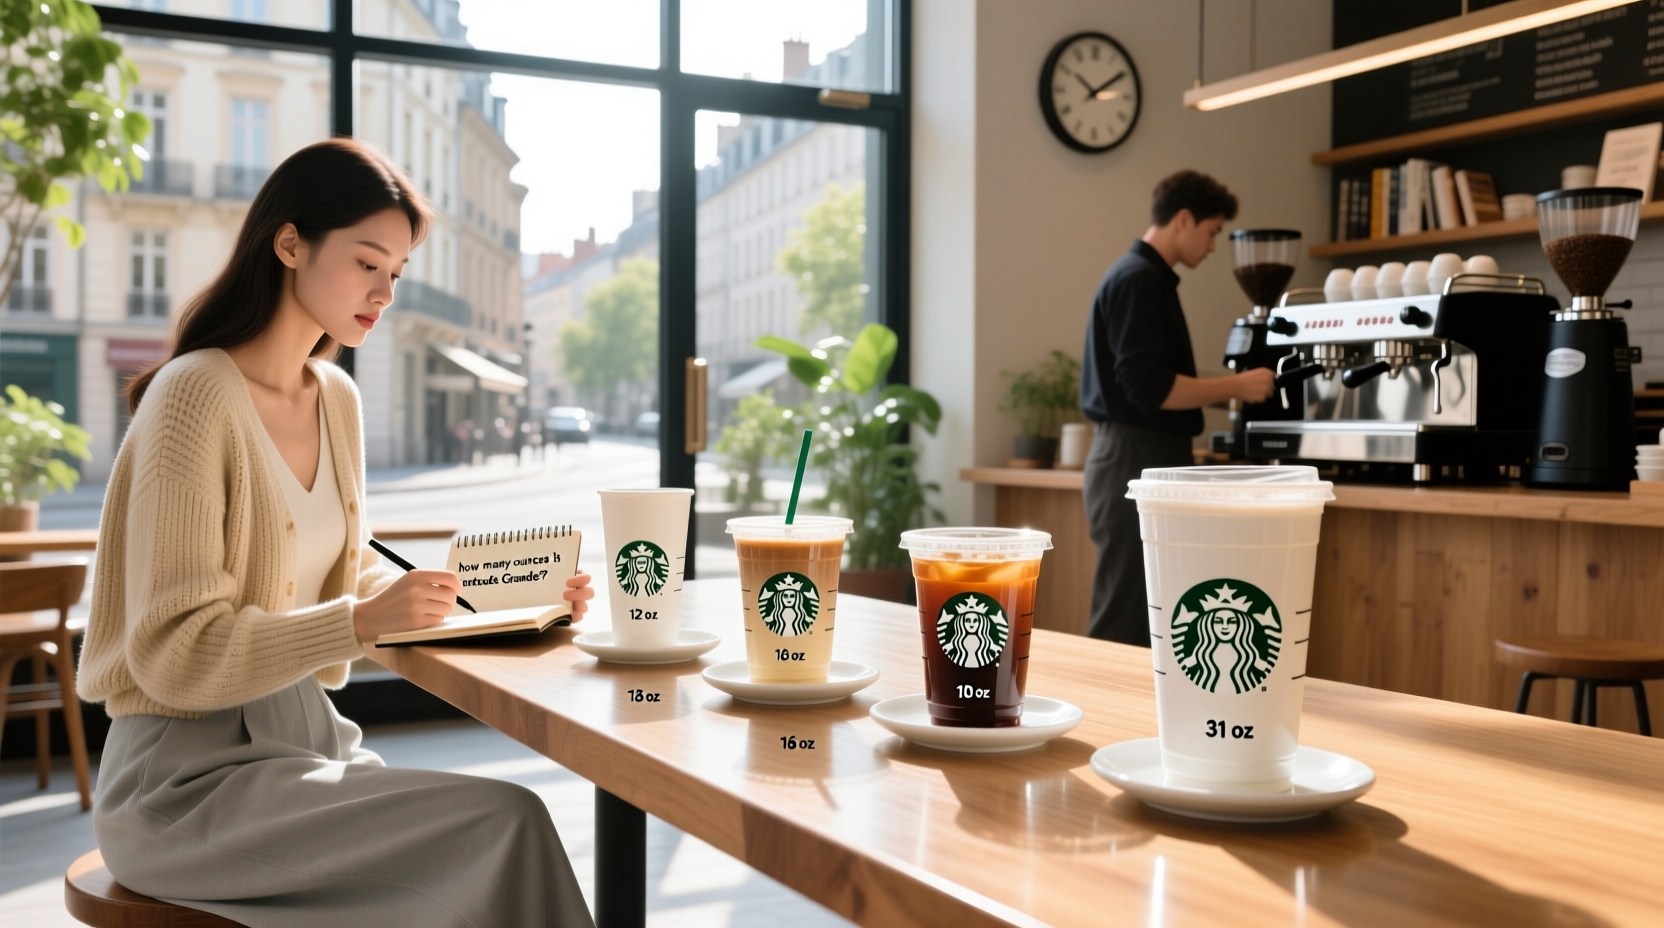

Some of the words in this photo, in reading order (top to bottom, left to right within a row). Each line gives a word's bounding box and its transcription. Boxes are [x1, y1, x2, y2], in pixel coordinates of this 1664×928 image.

[458, 561, 479, 572] how
[482, 559, 512, 571] many
[629, 608, 643, 620] 12
[644, 611, 658, 620] oz
[791, 652, 806, 661] oz
[645, 692, 661, 702] oz
[956, 684, 974, 699] 10
[975, 688, 990, 699] oz
[1205, 719, 1226, 739] 31
[1231, 725, 1254, 740] oz
[779, 734, 797, 750] 16
[798, 739, 816, 750] oz
